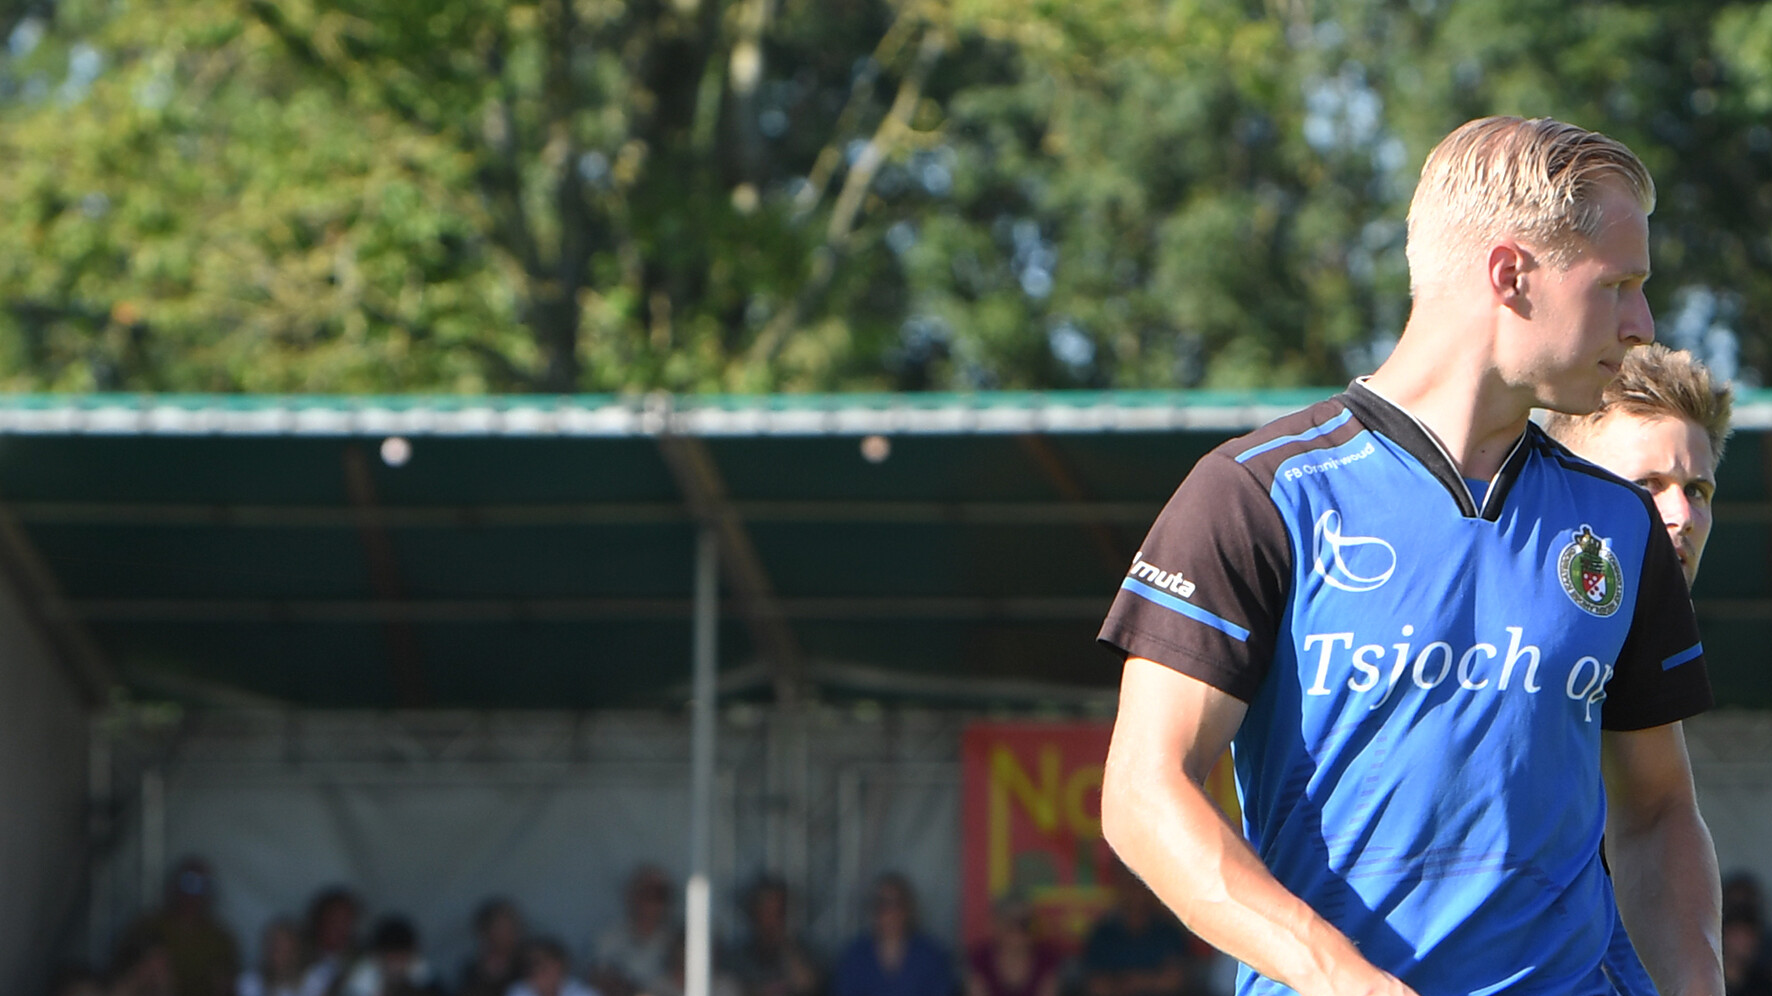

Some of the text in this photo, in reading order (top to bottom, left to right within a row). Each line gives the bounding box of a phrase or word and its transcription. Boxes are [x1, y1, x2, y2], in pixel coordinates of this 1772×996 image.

[1284, 466, 1303, 481] FB
[1129, 559, 1196, 599] muta
[1303, 624, 1541, 710] Tsjoch
